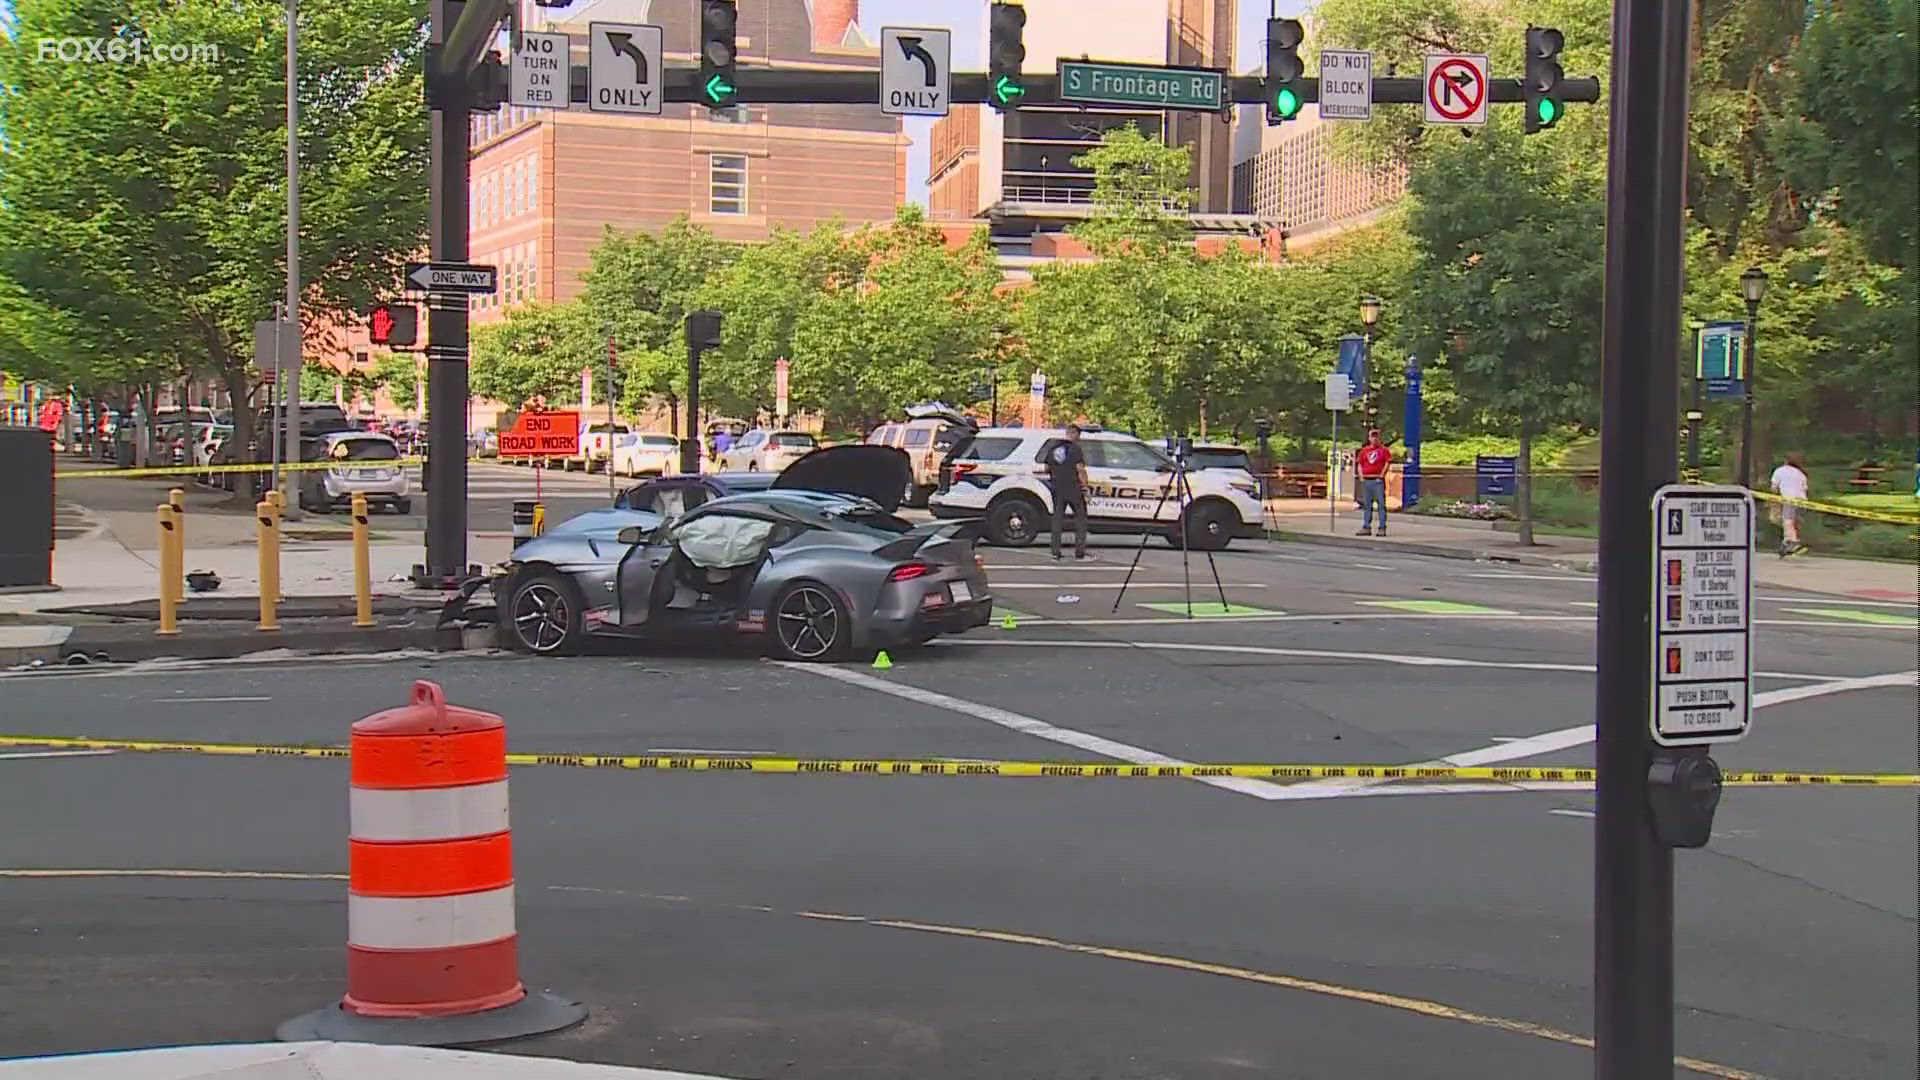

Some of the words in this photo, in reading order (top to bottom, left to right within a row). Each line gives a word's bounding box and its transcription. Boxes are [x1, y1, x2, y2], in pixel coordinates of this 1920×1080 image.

[526, 38, 553, 53] NO
[524, 57, 558, 70] TURN
[1323, 55, 1338, 68] DO
[1345, 56, 1368, 69] NOT
[530, 73, 550, 85] ON
[1070, 69, 1081, 90] S
[1092, 74, 1180, 102] Frontage
[1191, 79, 1214, 100] Rd
[1326, 81, 1365, 94] BLOCK
[527, 90, 553, 102] RED
[600, 87, 652, 107] ONLY
[891, 90, 940, 109] ONLY
[432, 271, 457, 284] ONE
[461, 272, 486, 284] WAY
[526, 418, 551, 432] END
[502, 436, 536, 450] ROAD
[541, 436, 575, 449] WORK
[1081, 485, 1155, 500] OLICE
[1105, 501, 1151, 511] HAVEN
[1676, 690, 1698, 703] PUSH
[1700, 689, 1729, 702] BUTTON
[1683, 713, 1694, 725] TO
[1697, 711, 1721, 724] CROSS
[797, 761, 842, 773] POLICE
[957, 763, 1000, 775] CROSS
[1040, 766, 1084, 777] POLICE
